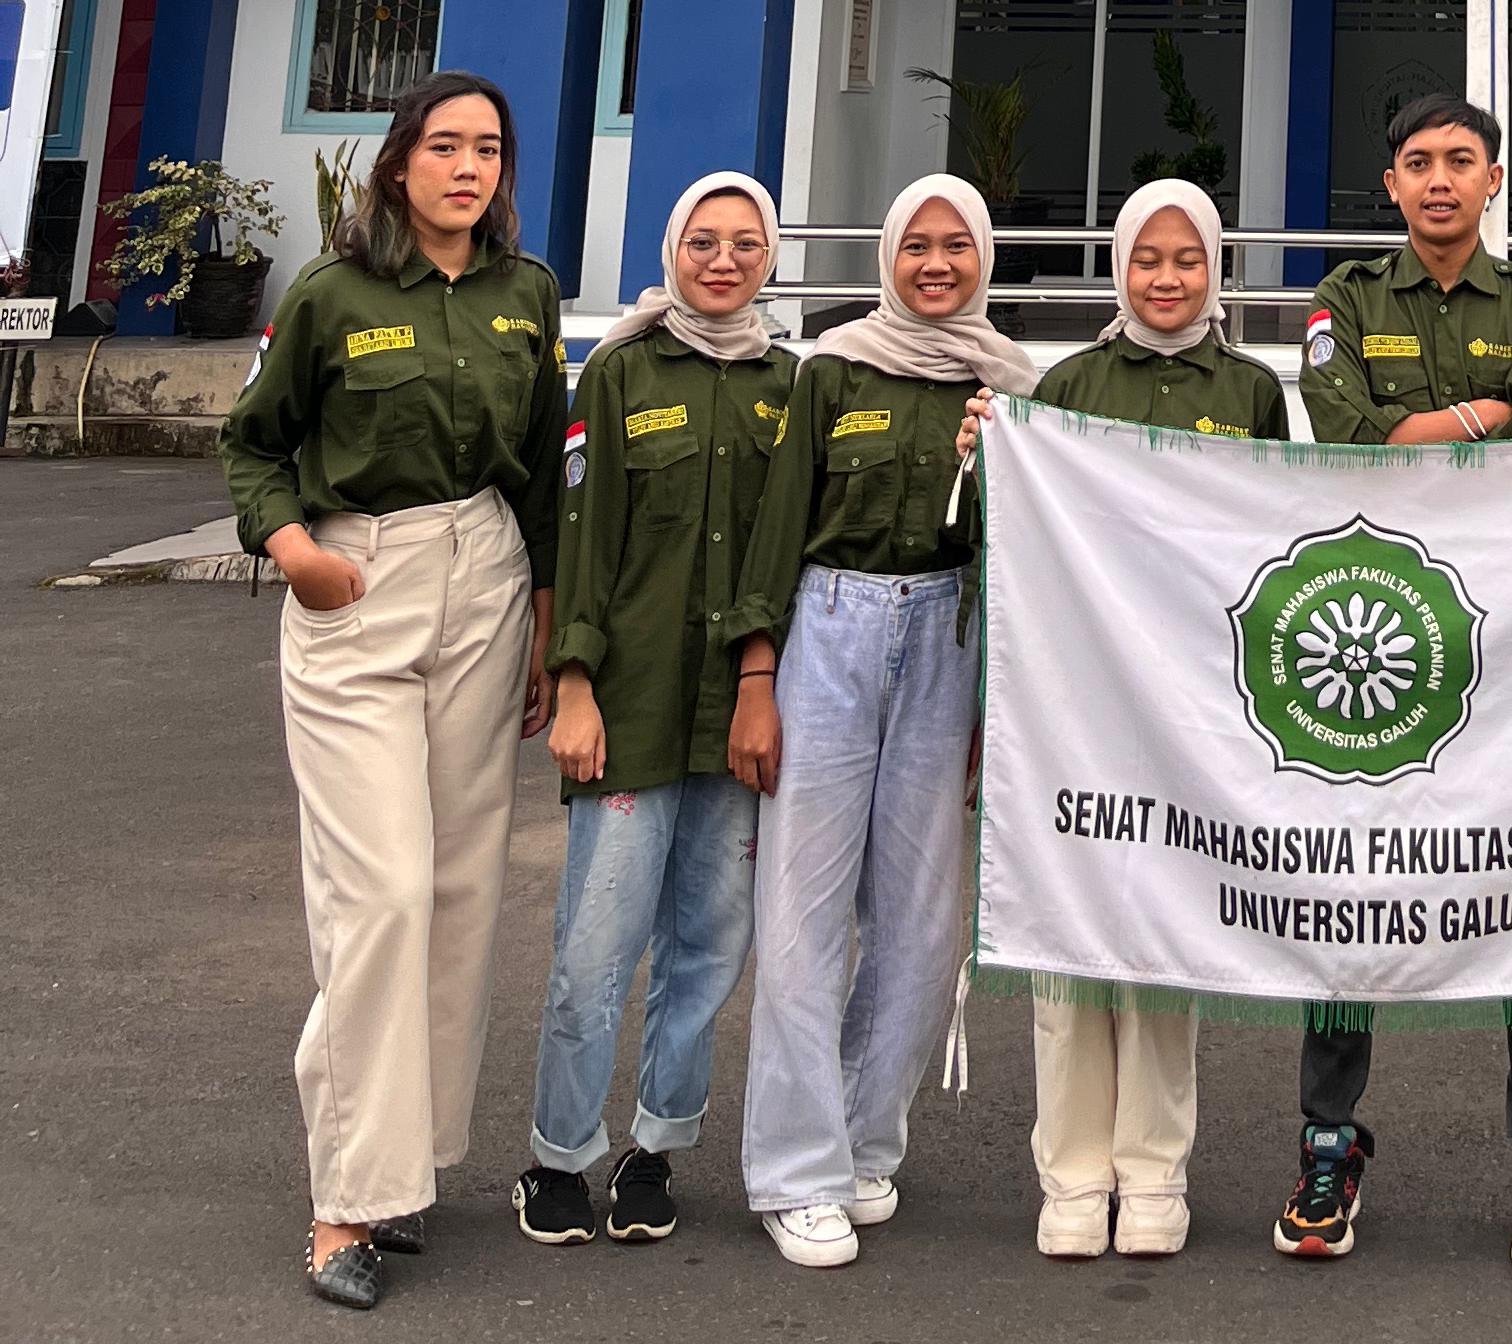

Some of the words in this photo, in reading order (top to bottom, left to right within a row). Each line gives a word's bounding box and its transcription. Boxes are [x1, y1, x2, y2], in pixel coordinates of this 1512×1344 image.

[1274, 566, 1349, 633] MAHASISWA
[1351, 565, 1422, 606] FAKULTAS
[1270, 633, 1287, 686] SENAT
[1415, 602, 1445, 691] PERTANIAN
[1286, 699, 1379, 749] UNIVERSITAS
[1380, 702, 1429, 744] GALUH
[1055, 788, 1156, 843] SENAT
[1164, 803, 1355, 875] MAHASISWA
[1219, 882, 1428, 945] UNIVERSITAS
